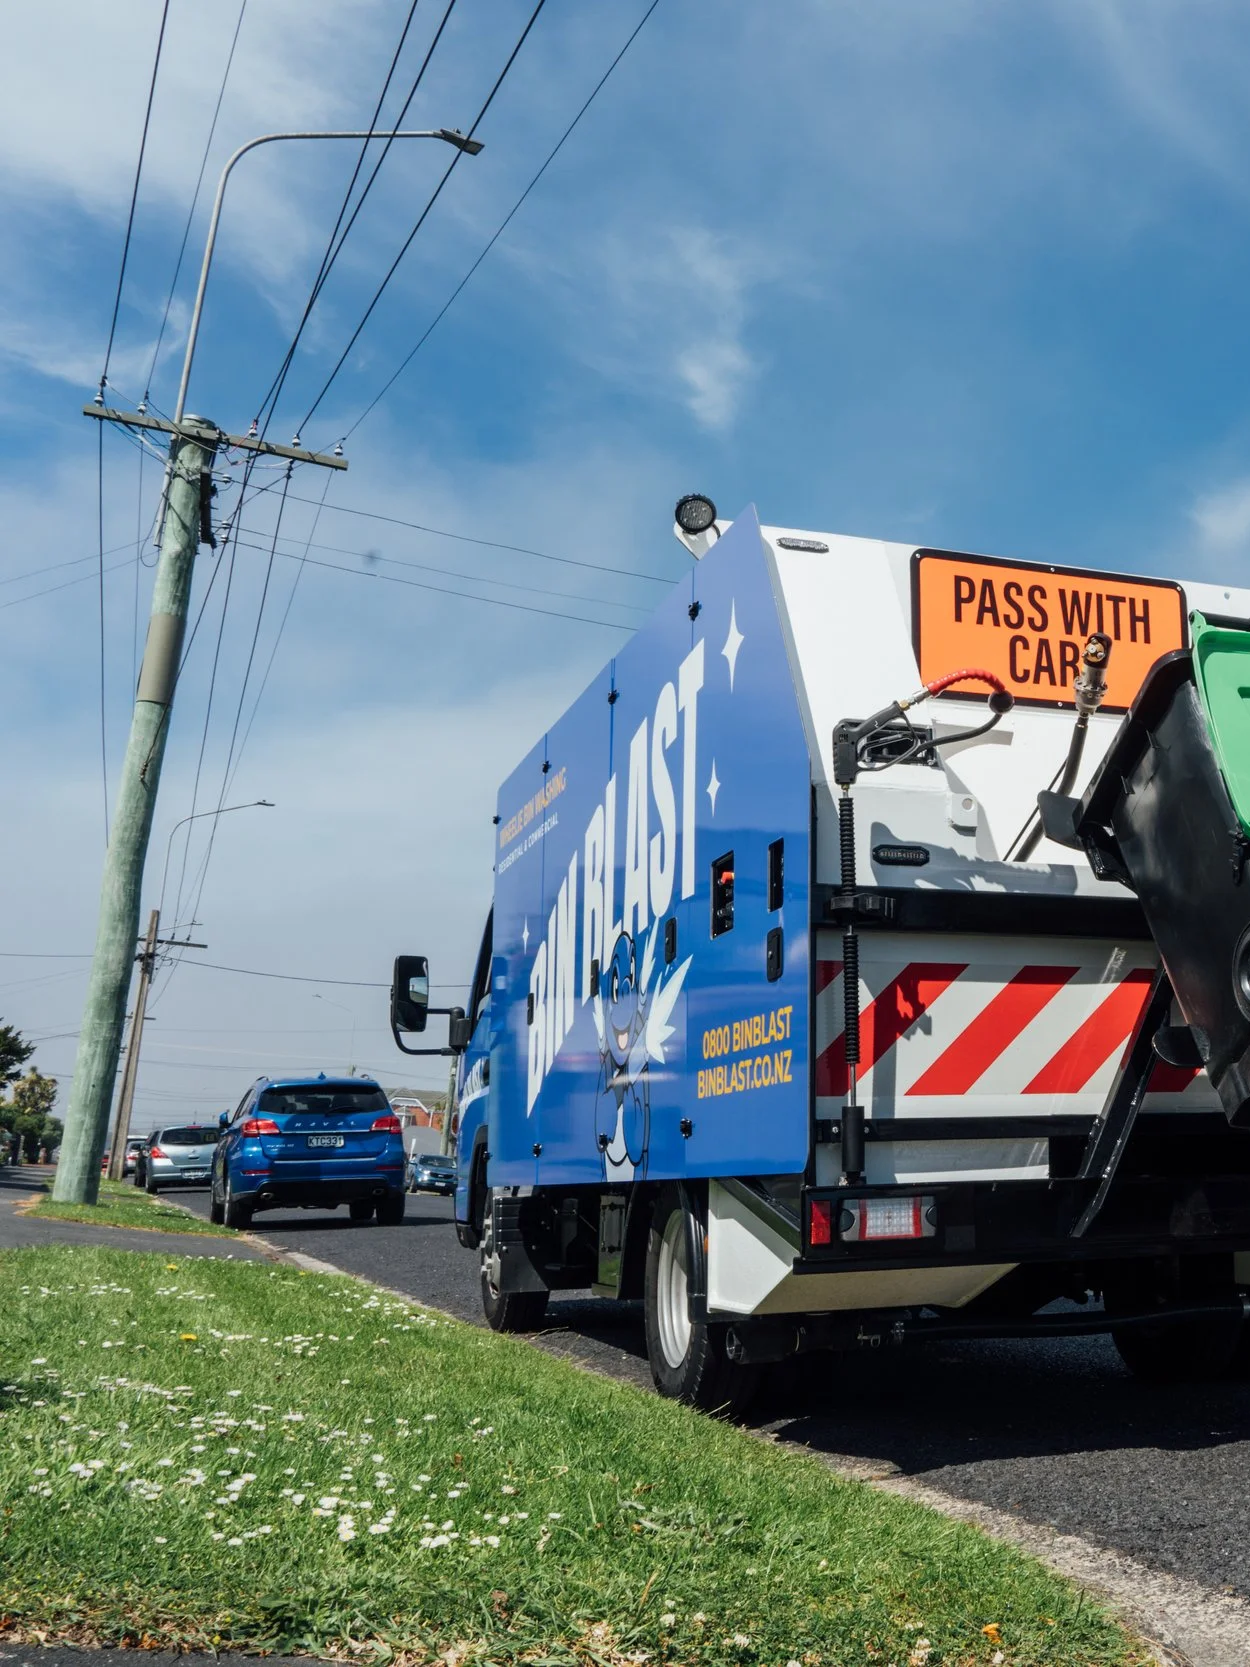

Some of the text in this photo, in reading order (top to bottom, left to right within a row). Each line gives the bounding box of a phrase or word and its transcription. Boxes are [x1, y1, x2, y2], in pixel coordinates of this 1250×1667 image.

[954, 575, 1151, 644] PASS WITH
[1009, 634, 1087, 687] CAR
[527, 637, 705, 1118] BIN BLAST
[703, 1005, 793, 1060] 0800 BINBLAST
[697, 1049, 793, 1099] BINBLAST.CO.NZ
